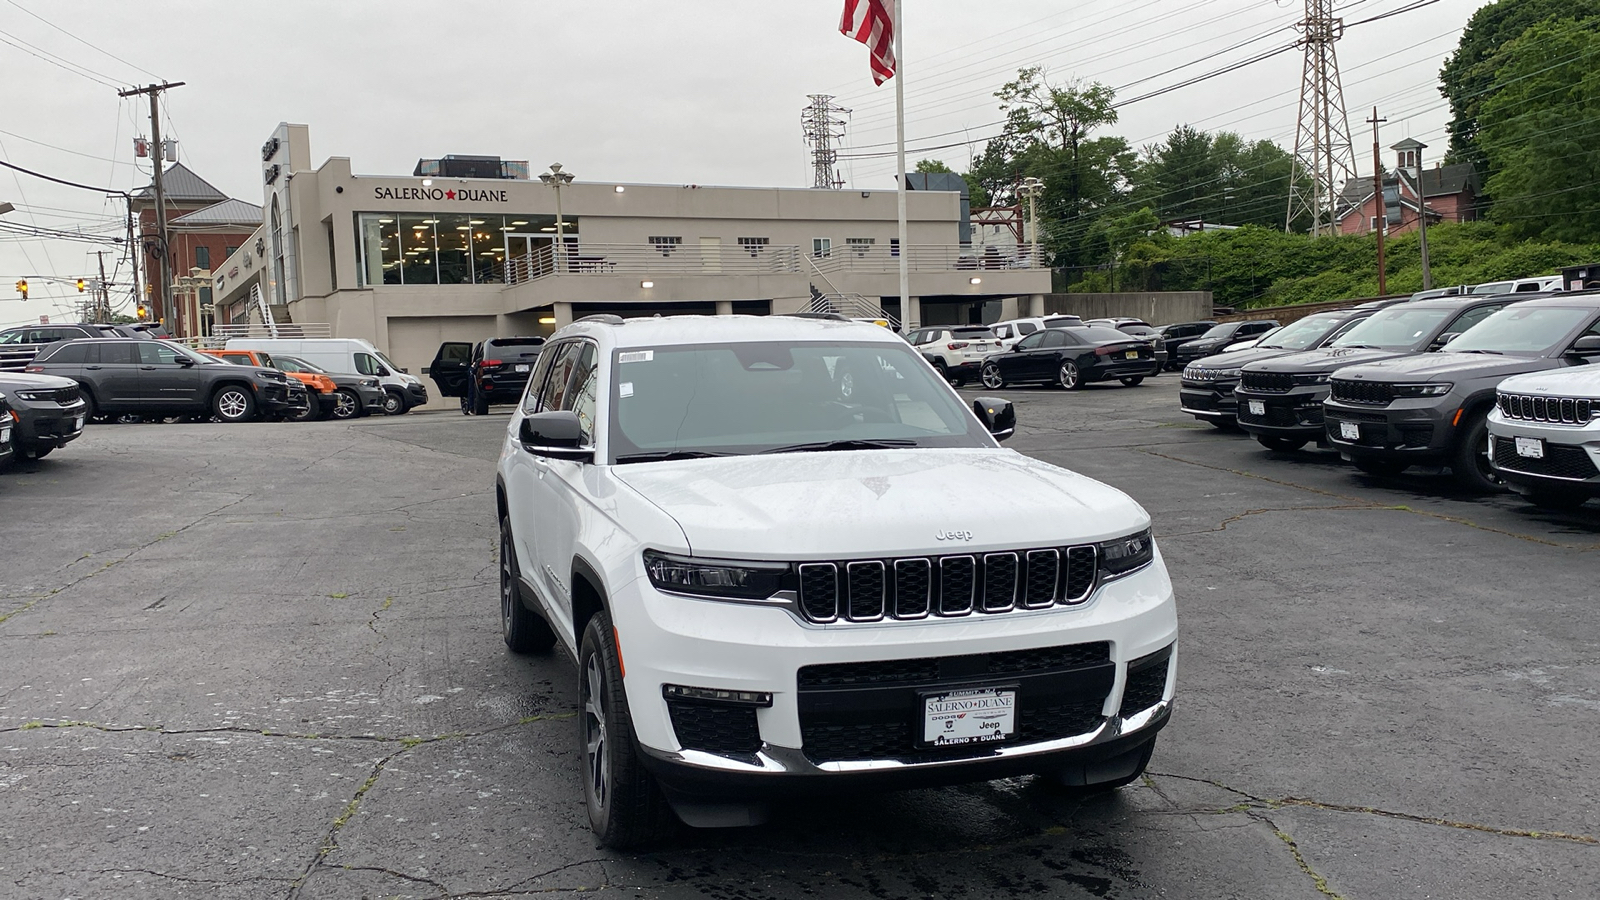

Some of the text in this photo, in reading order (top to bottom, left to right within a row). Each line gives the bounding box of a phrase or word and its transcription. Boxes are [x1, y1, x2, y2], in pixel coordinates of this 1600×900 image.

[374, 187, 508, 202] SALERNO DUANE
[935, 528, 973, 542] Jeep
[927, 700, 973, 713] SALERNO
[978, 697, 1013, 709] DUANE
[979, 721, 1000, 730] Jeep
[934, 733, 1006, 746] SALERNO DUANE
